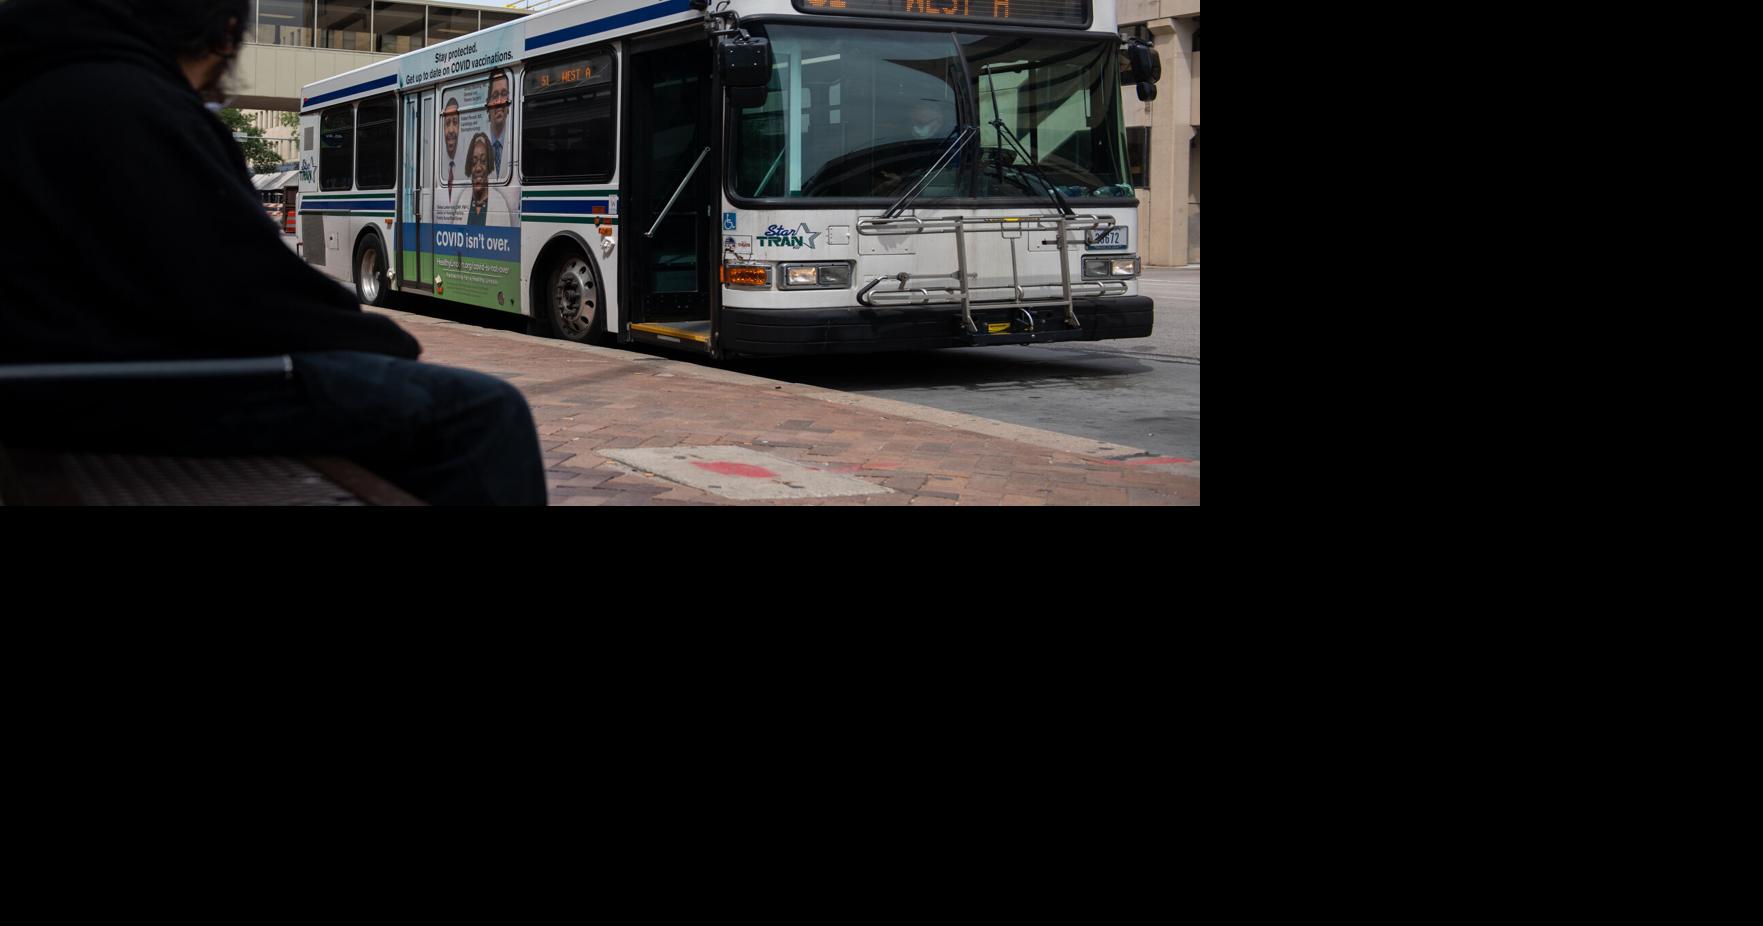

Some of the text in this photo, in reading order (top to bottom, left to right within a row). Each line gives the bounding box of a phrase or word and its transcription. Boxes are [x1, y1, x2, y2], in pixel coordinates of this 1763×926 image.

[434, 43, 477, 63] Stay protected.
[405, 50, 513, 84] Get up to date on COVID vaccinations.
[764, 224, 797, 237] Star
[436, 231, 510, 251] COVID isn't over.
[756, 236, 803, 247] TRAN
